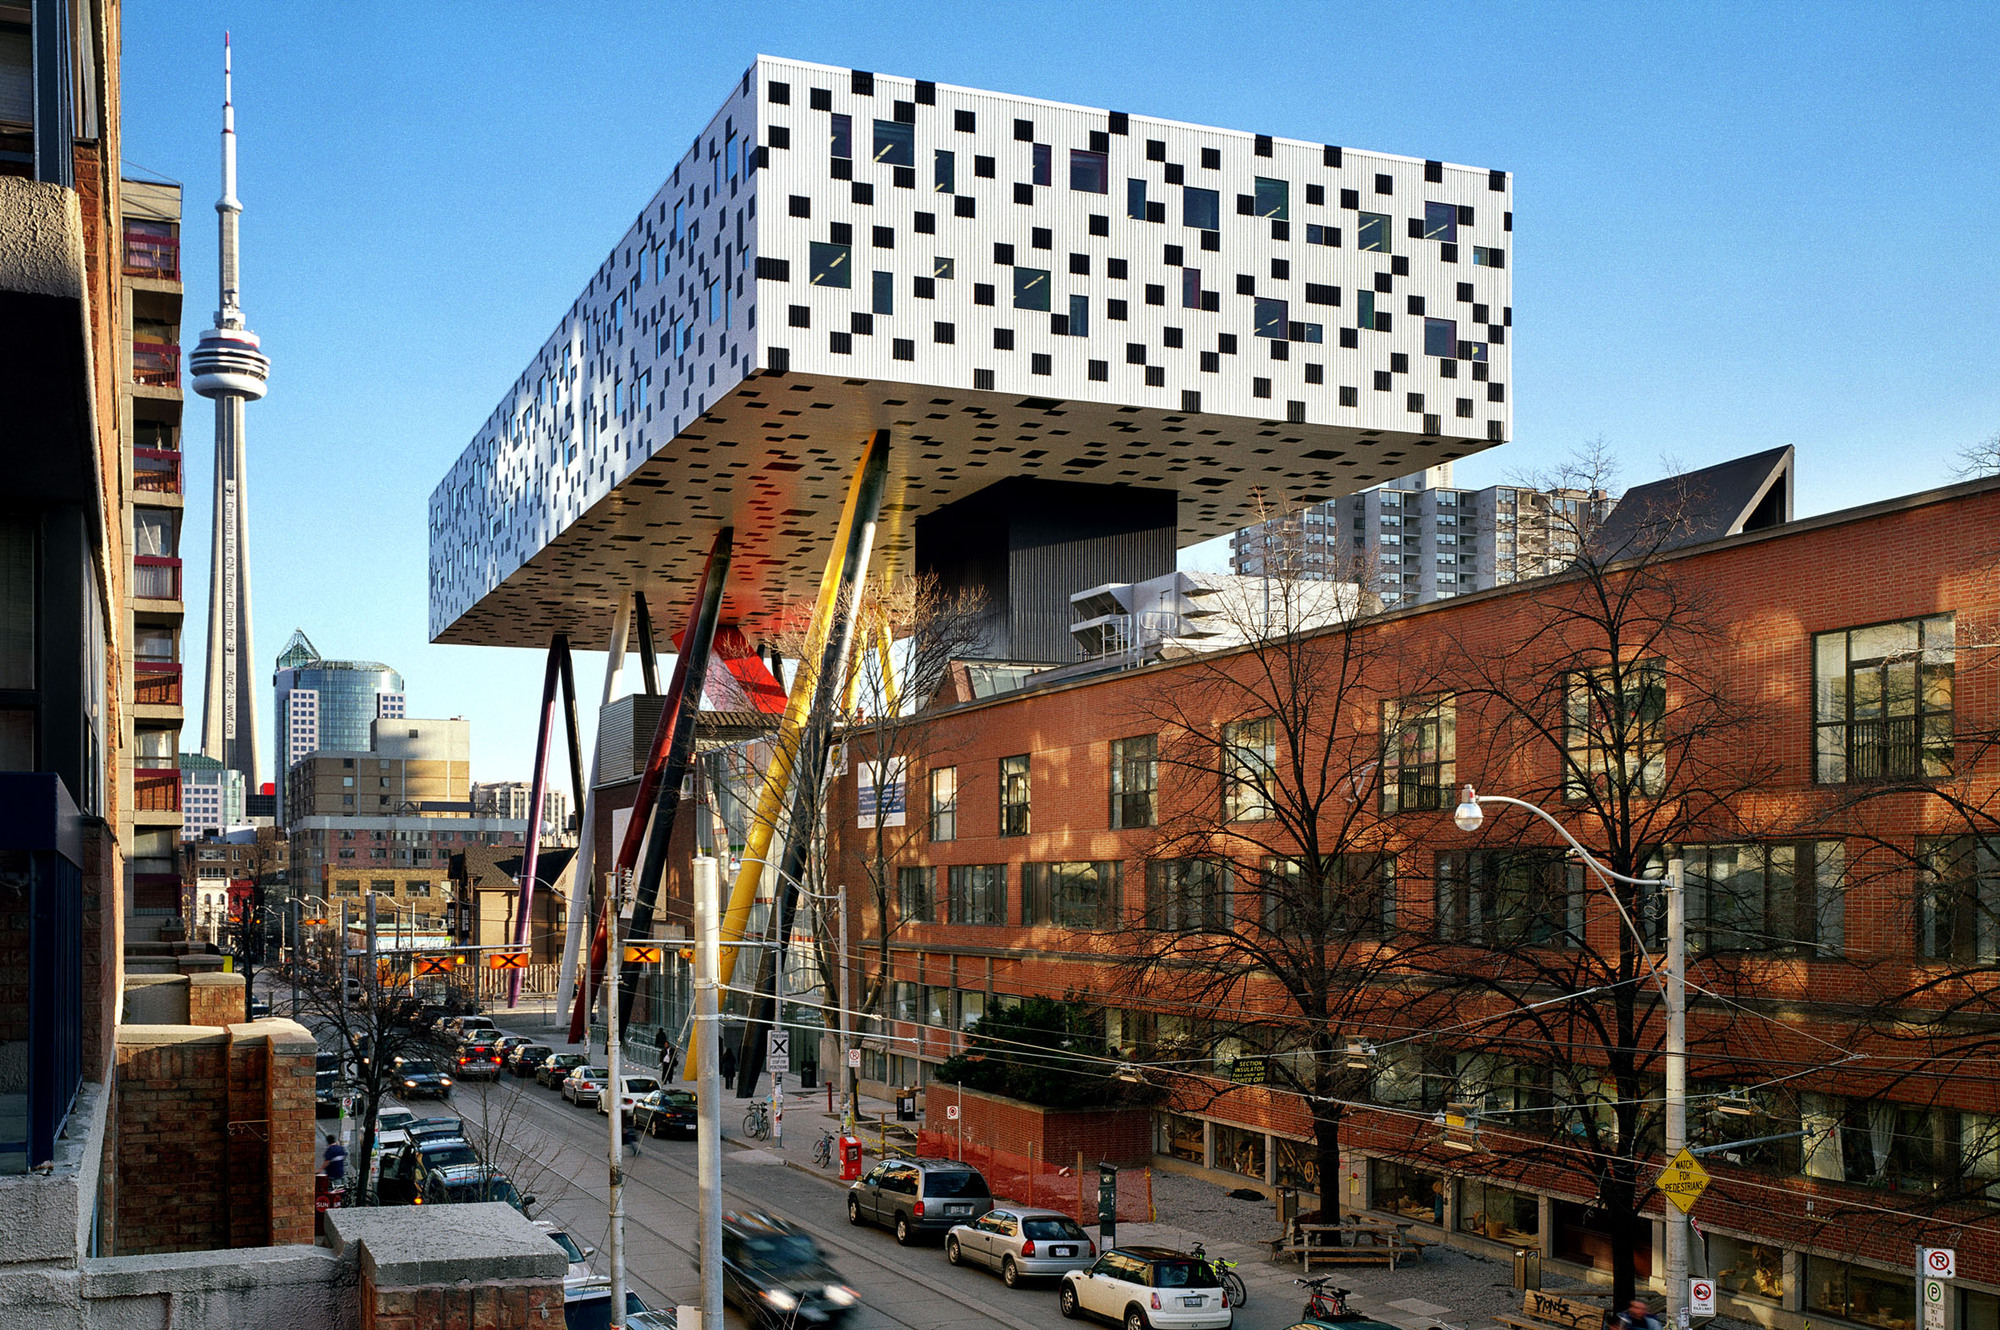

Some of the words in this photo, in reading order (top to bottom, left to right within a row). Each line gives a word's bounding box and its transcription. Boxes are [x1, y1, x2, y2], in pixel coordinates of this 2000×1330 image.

[226, 501, 235, 536] Canada
[226, 537, 235, 554] Life
[226, 556, 235, 570] CN
[226, 573, 235, 597] Tower
[226, 601, 235, 627] Climb
[226, 628, 235, 641] for
[1675, 1159, 1694, 1169] WATCH
[1679, 1171, 1691, 1181] FOR
[1664, 1180, 1704, 1192] PEDESTRIANS
